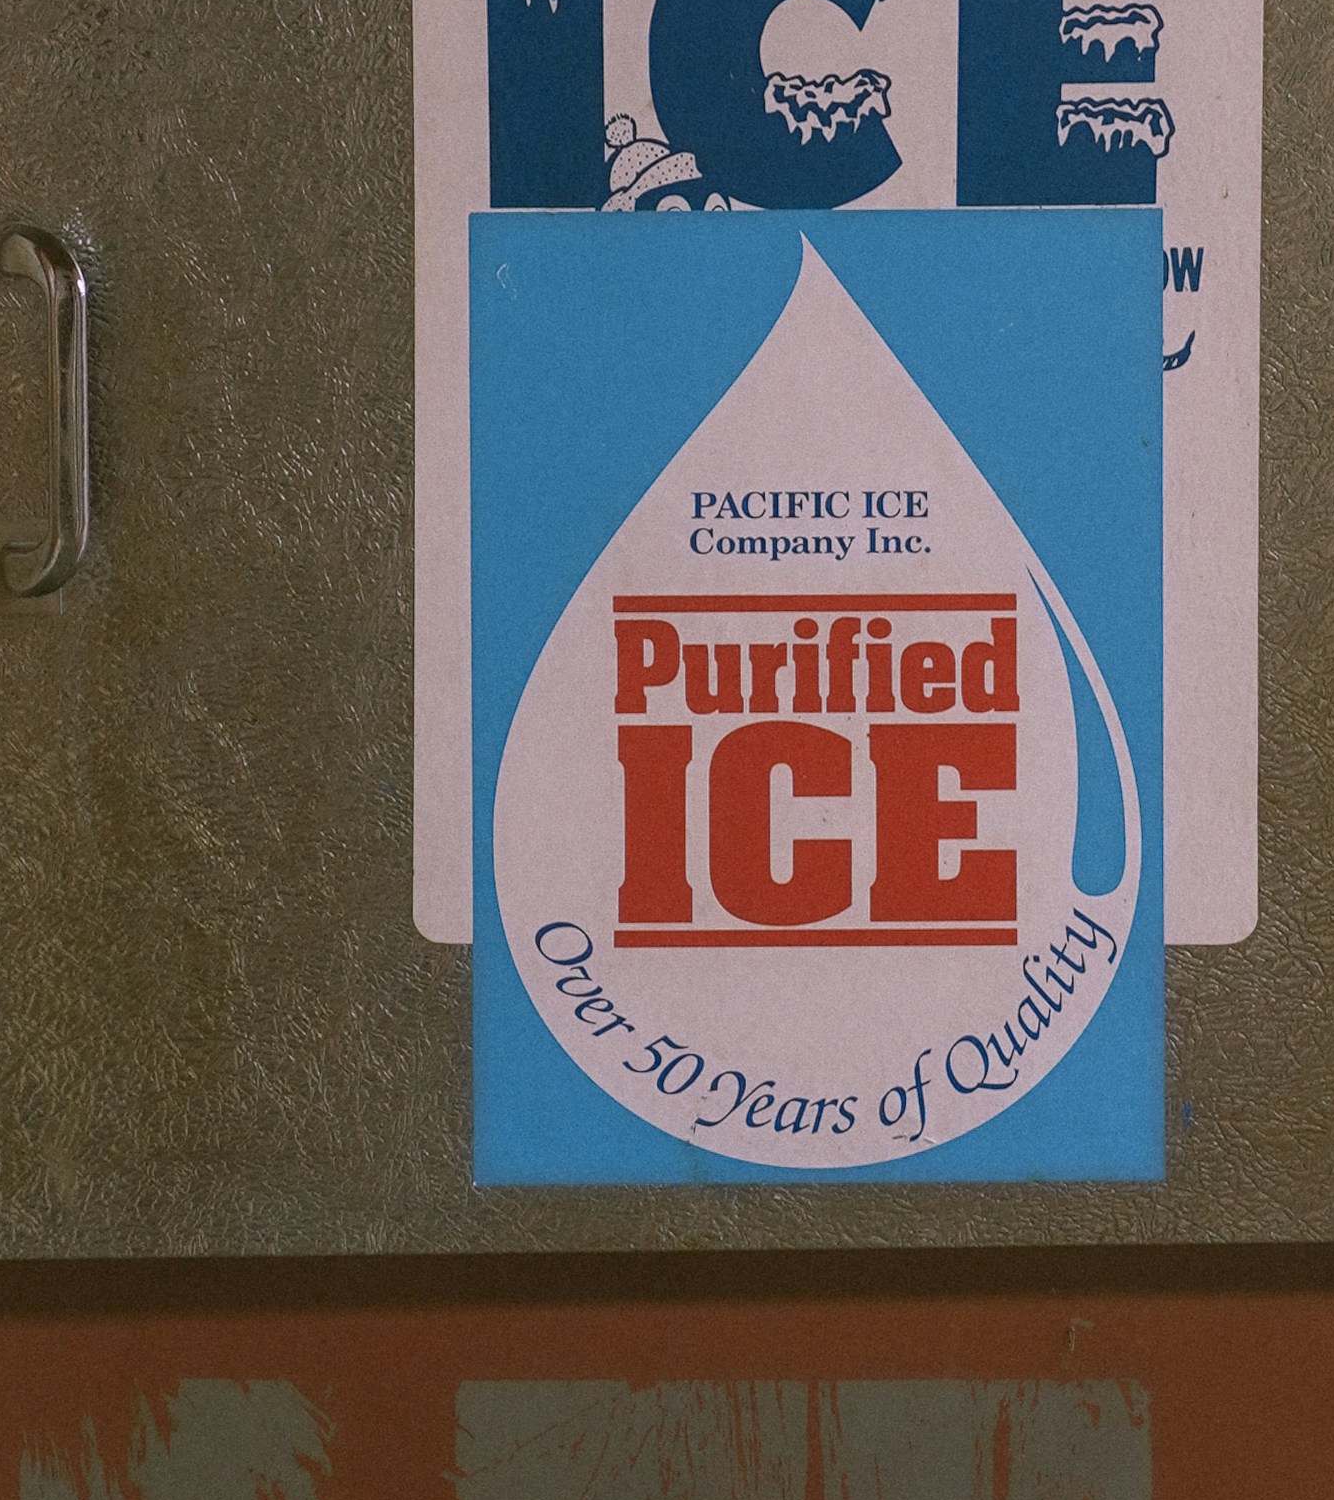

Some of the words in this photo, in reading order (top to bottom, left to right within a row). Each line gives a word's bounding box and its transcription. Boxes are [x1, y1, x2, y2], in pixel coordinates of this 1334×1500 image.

[688, 527, 856, 562] Company
[865, 526, 933, 556] Inc.
[690, 490, 853, 521] PACIFIC
[861, 490, 930, 520] ICE
[613, 616, 1021, 715] Purified
[617, 720, 1019, 928] ICE
[532, 918, 636, 1041] Over
[622, 1034, 706, 1097] 50
[694, 1068, 859, 1136] Years
[878, 1049, 934, 1142] of
[944, 906, 1120, 1094] Quality
